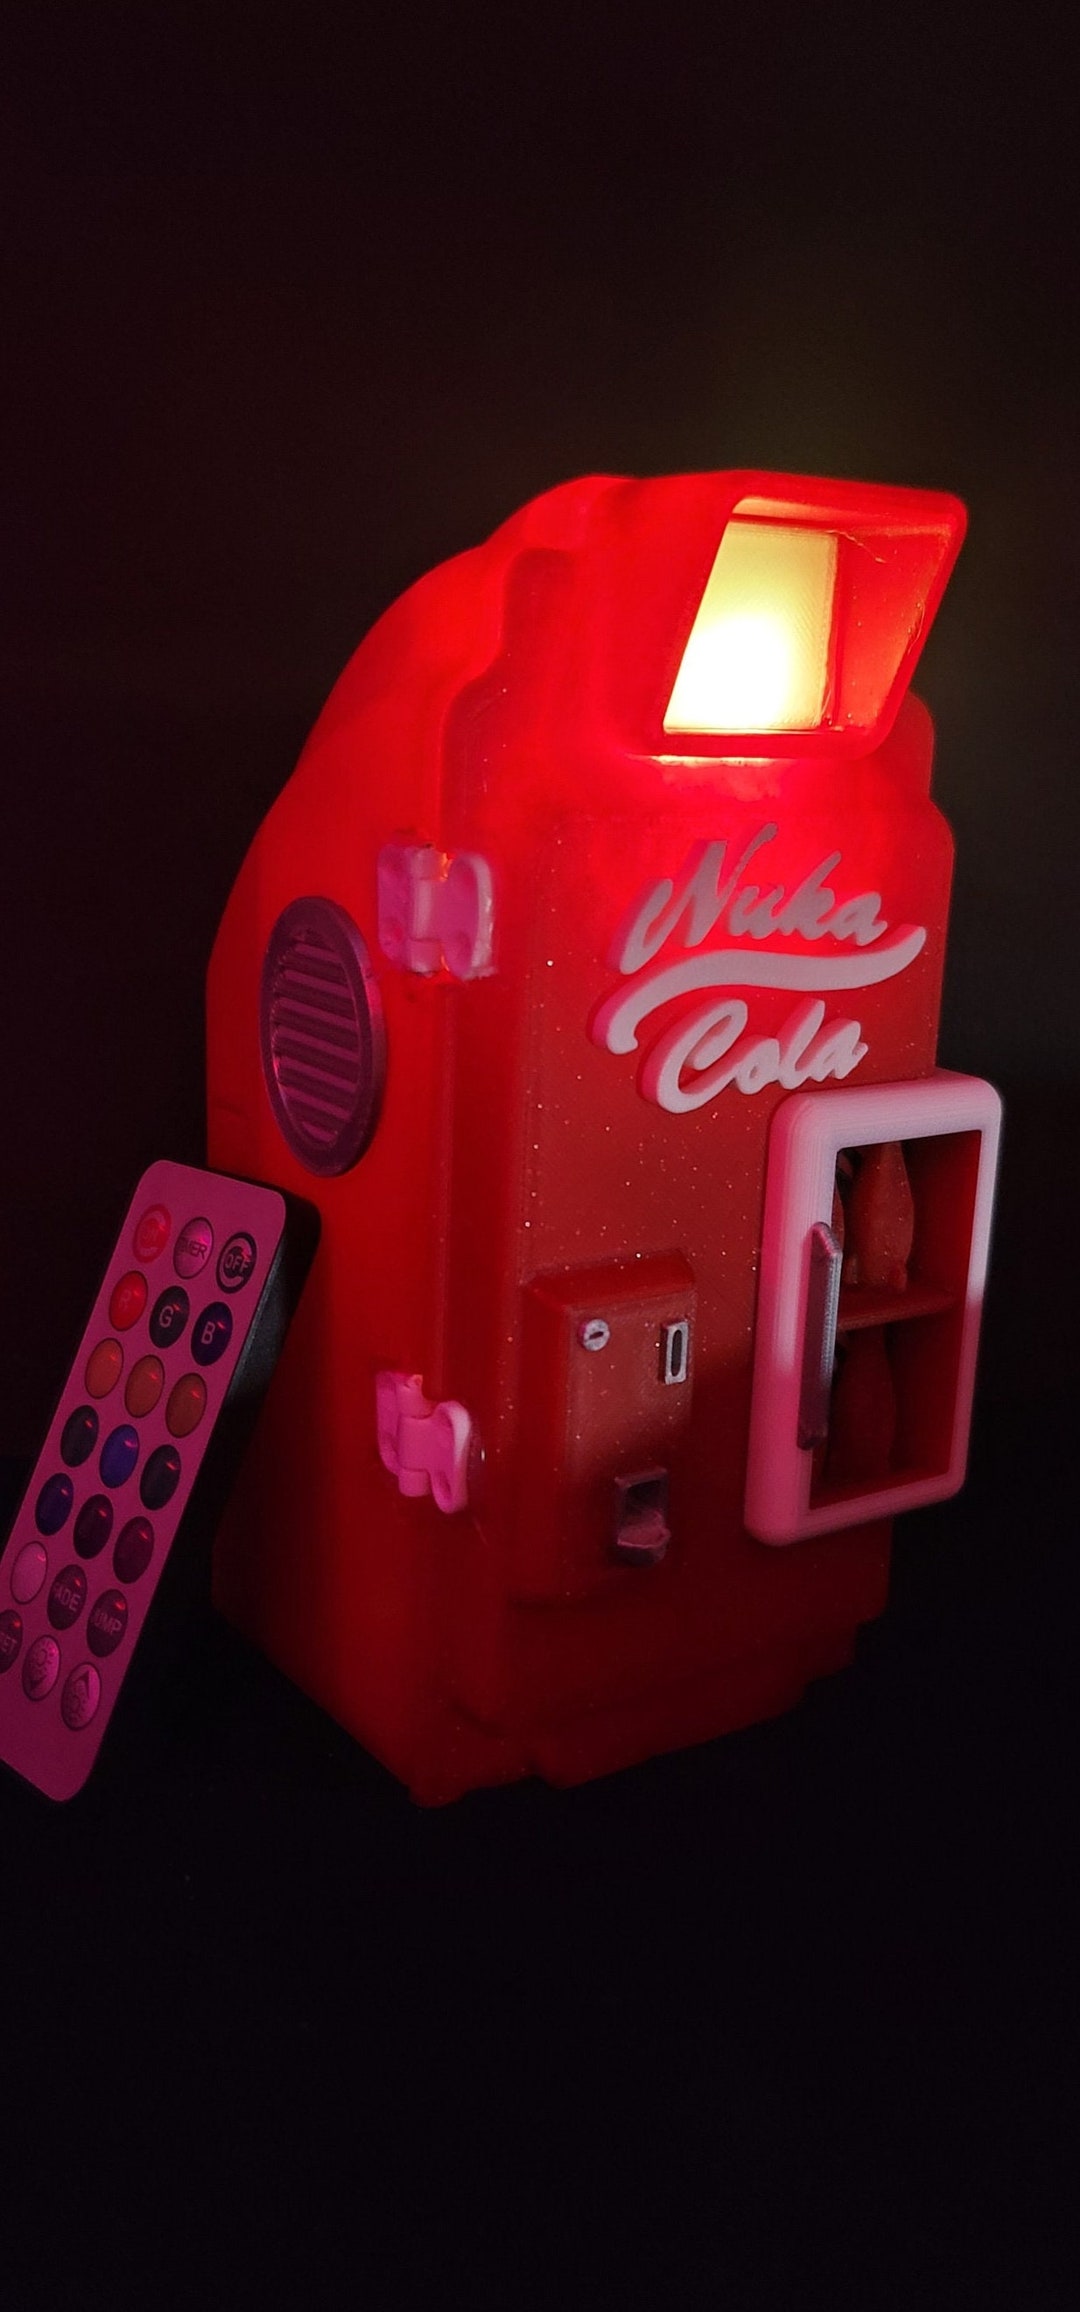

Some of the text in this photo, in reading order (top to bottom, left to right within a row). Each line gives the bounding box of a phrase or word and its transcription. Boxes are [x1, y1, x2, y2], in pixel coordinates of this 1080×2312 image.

[614, 822, 887, 975] Nuka
[650, 998, 868, 1113] Cola
[224, 1253, 250, 1273] OFF
[159, 1305, 174, 1328] G
[201, 1321, 216, 1344] B
